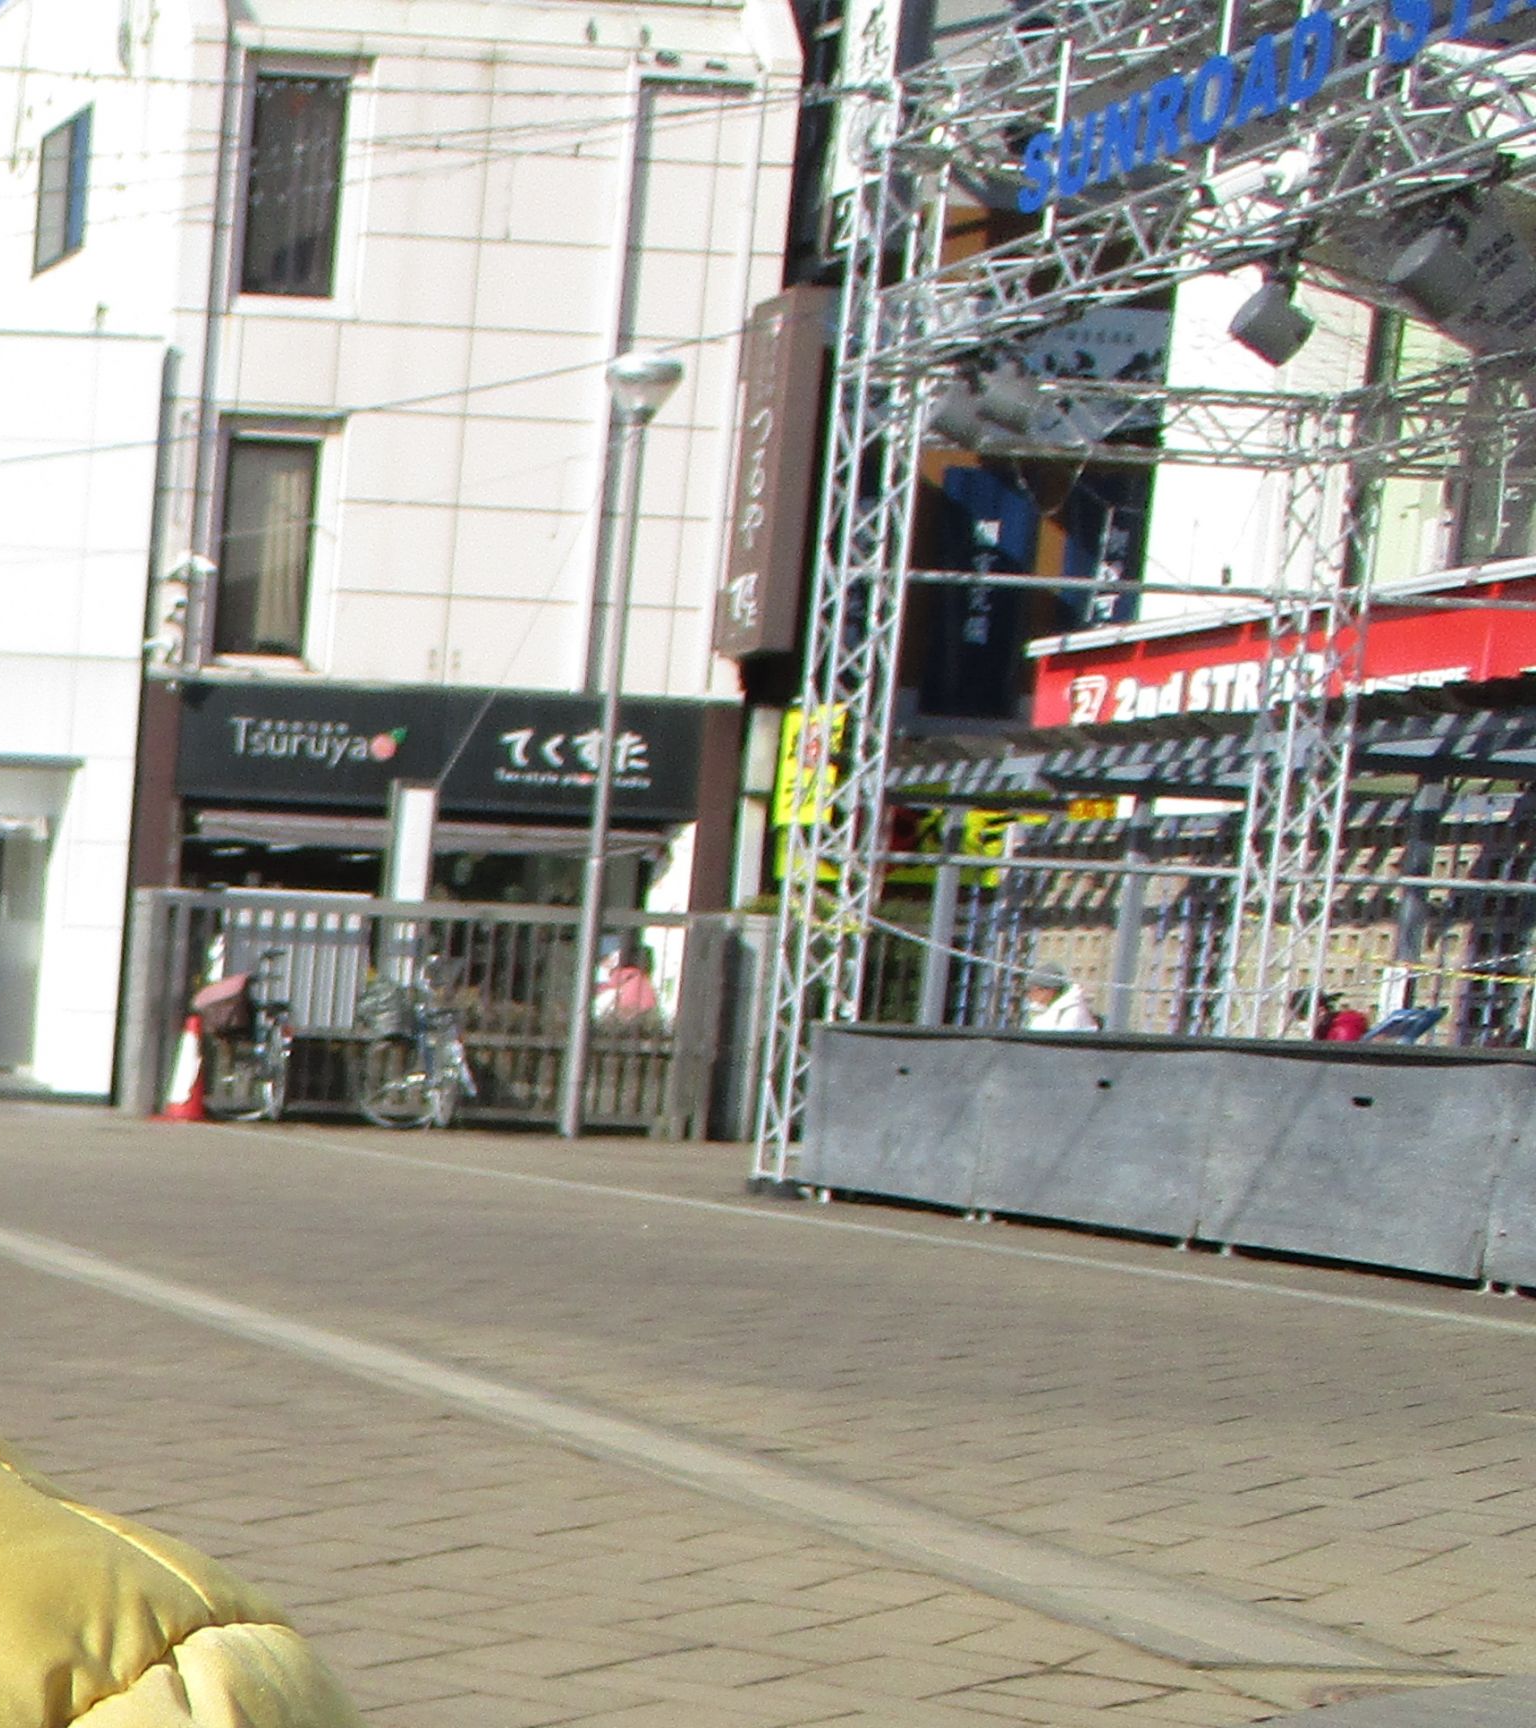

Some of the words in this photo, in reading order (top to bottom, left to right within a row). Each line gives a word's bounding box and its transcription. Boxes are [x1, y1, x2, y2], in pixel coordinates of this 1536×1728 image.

[1018, 9, 1335, 214] SUNROAD
[1114, 670, 1185, 722] 2nd
[230, 715, 370, 769] Tsuruya
